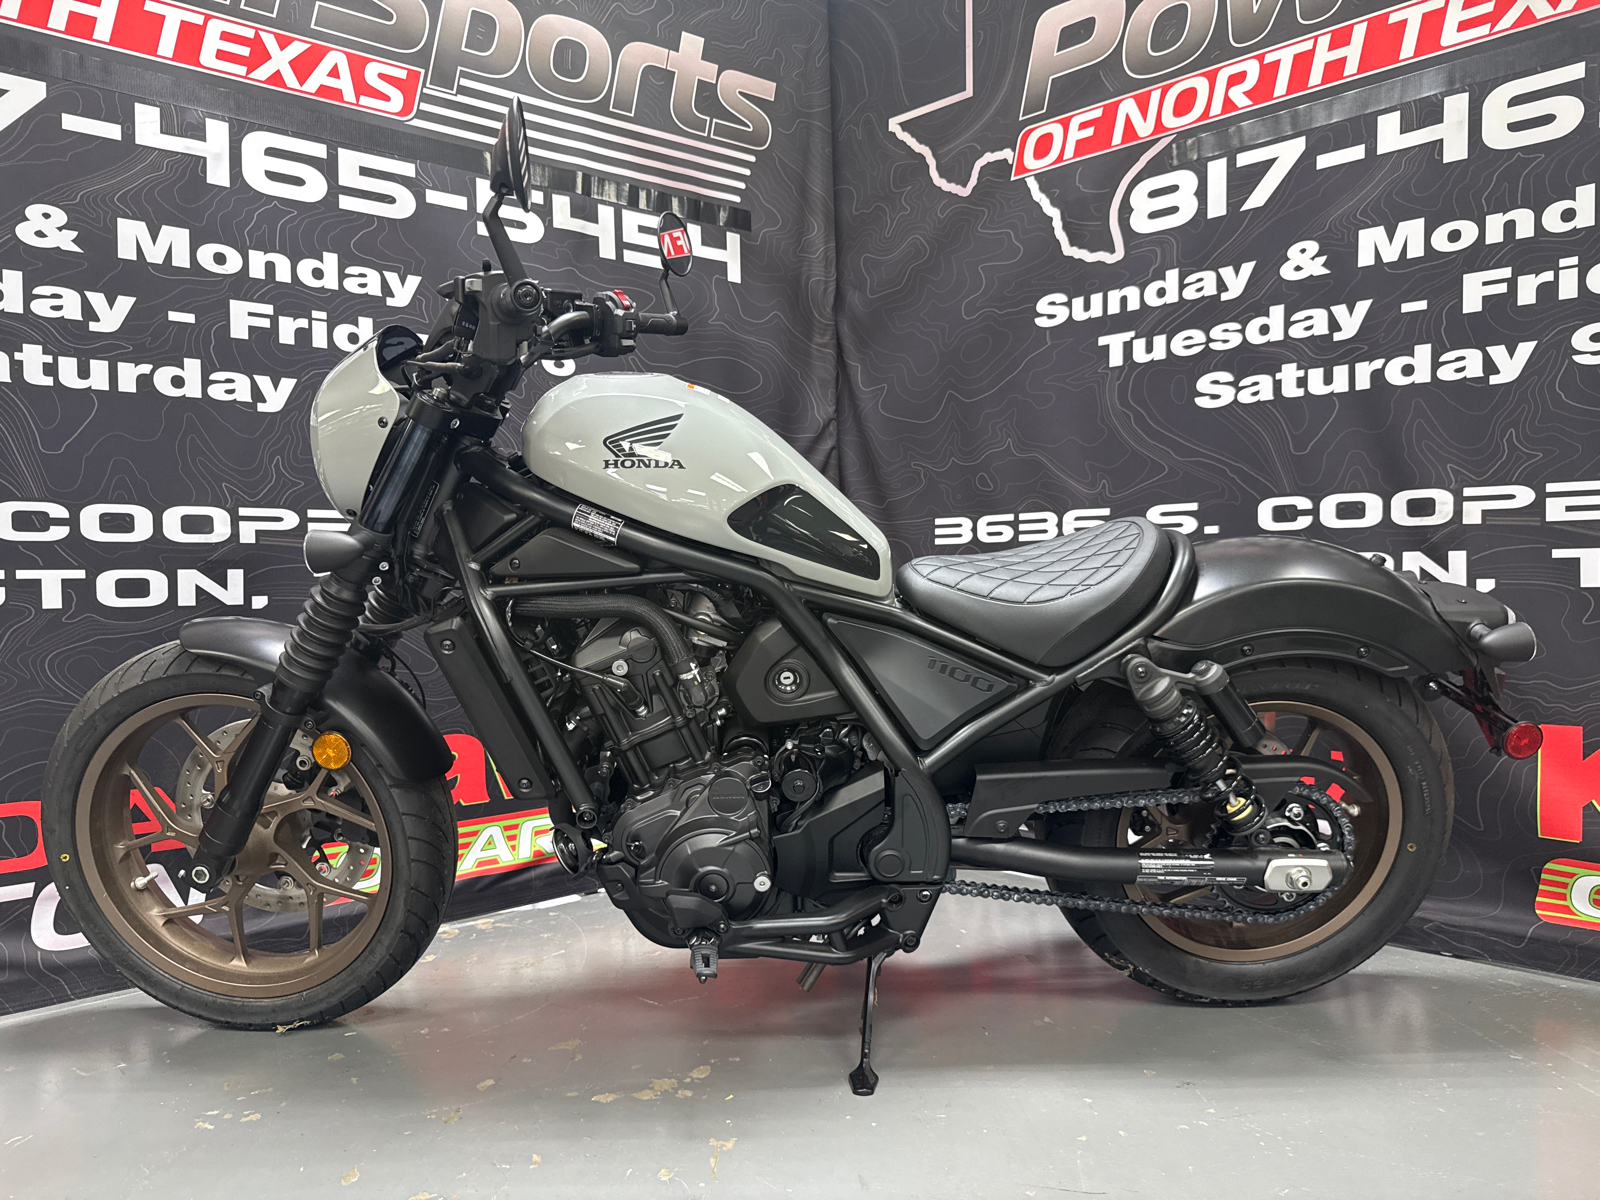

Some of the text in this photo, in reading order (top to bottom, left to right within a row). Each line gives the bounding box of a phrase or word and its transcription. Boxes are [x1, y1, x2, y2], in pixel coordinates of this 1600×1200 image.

[143, 3, 408, 114] TEXAS
[1022, 0, 1577, 170] OF NORTH TEX
[15, 203, 422, 307] & Monday
[1033, 182, 1597, 329] Sunday & Mond
[229, 298, 376, 353] Frid
[1097, 298, 1374, 369] Tuesday
[1194, 339, 1539, 410] Saturday
[602, 458, 687, 470] HONDA
[0, 568, 269, 610] TON,
[926, 655, 995, 692] 1100
